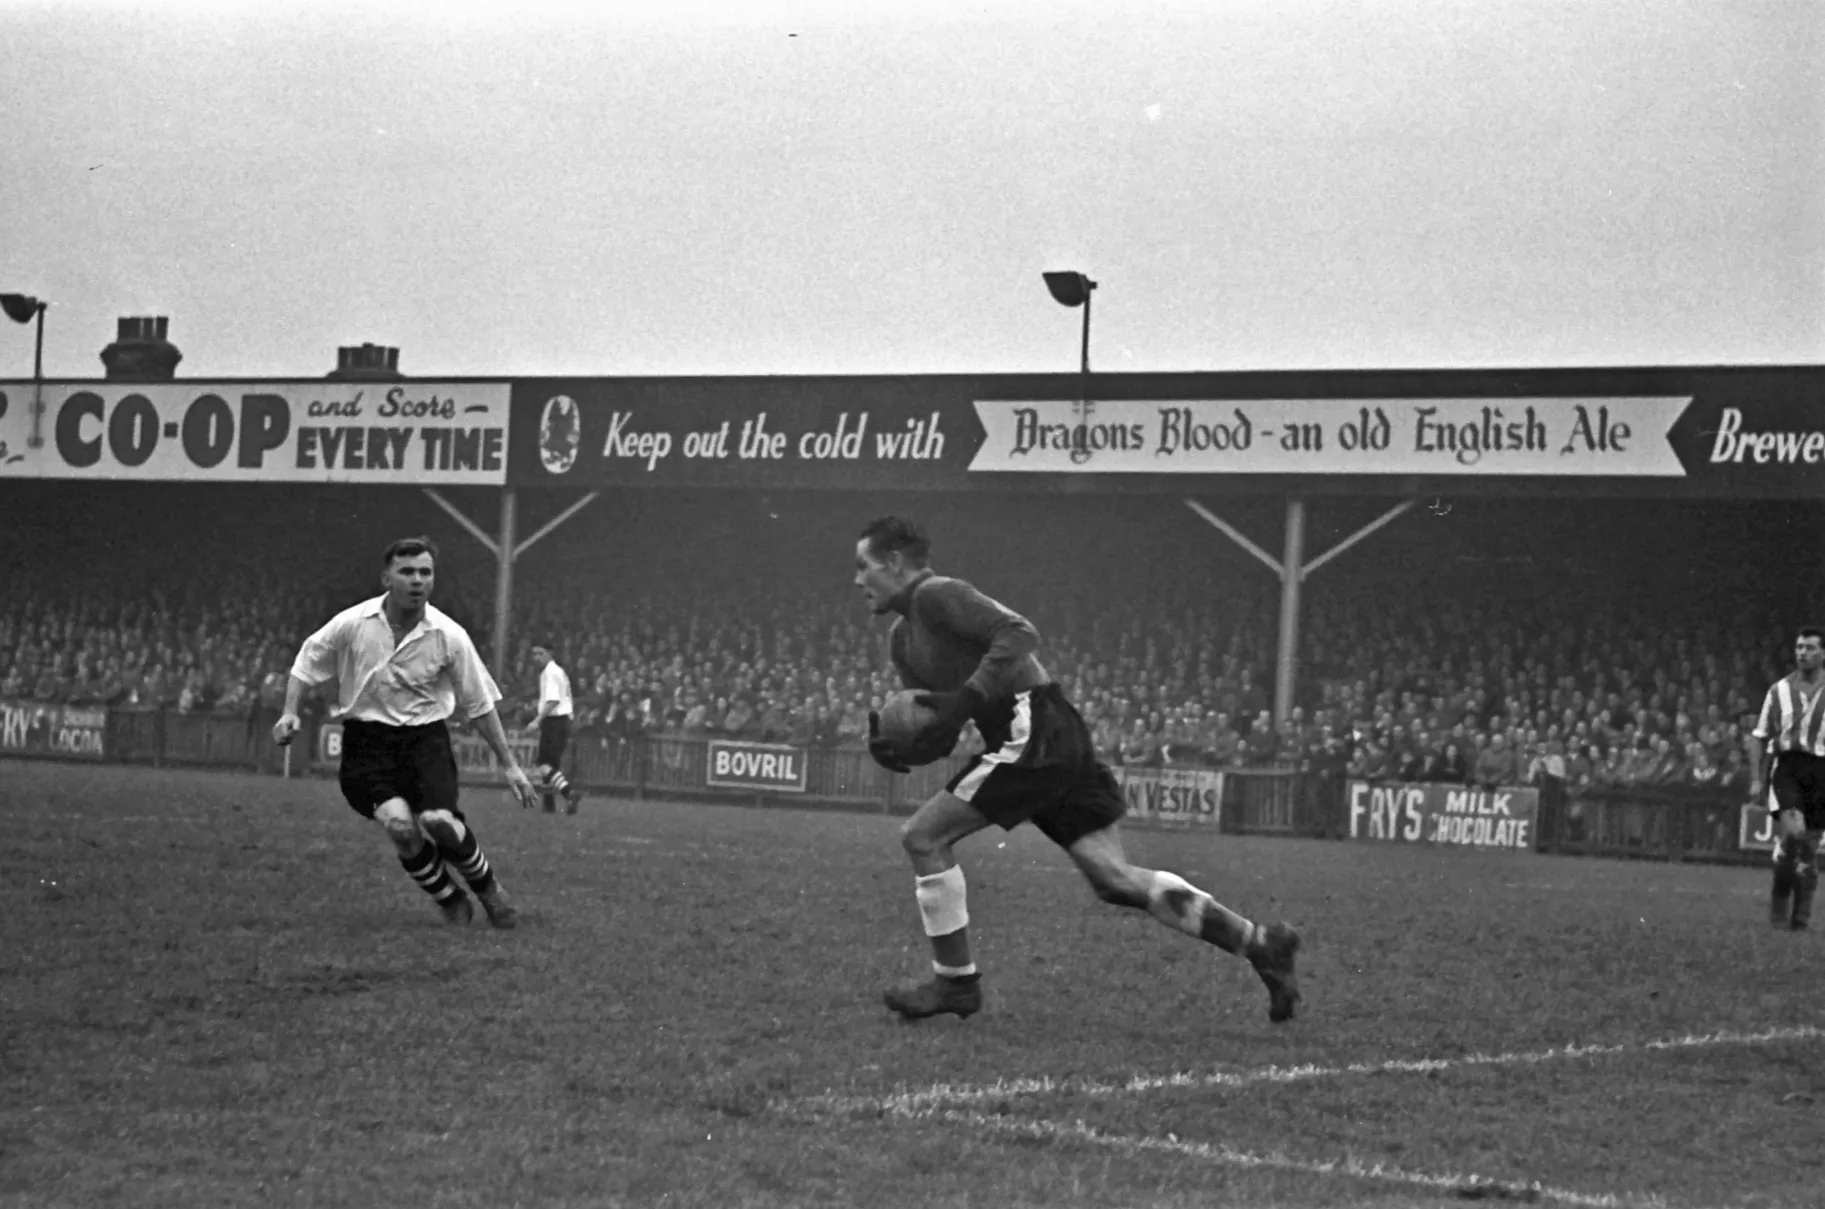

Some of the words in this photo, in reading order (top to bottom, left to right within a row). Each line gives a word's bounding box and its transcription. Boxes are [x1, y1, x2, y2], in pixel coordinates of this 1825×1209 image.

[308, 388, 364, 418] and
[377, 385, 456, 420] Score
[55, 391, 291, 468] CO-OP
[296, 426, 414, 470] EVERY
[420, 427, 503, 471] TIME
[603, 411, 672, 472] Keep
[683, 421, 729, 459] out
[739, 411, 786, 459] the
[799, 411, 868, 459] cold
[876, 411, 945, 459] with
[1009, 408, 1145, 465] Dragons
[1337, 406, 1392, 451] old
[1414, 404, 1547, 466] English
[1560, 404, 1632, 457] Ale
[1709, 407, 1825, 464] Brewe
[715, 751, 798, 780] BOVRIL
[1146, 782, 1216, 815] VESTAS
[1445, 791, 1513, 815] MILK
